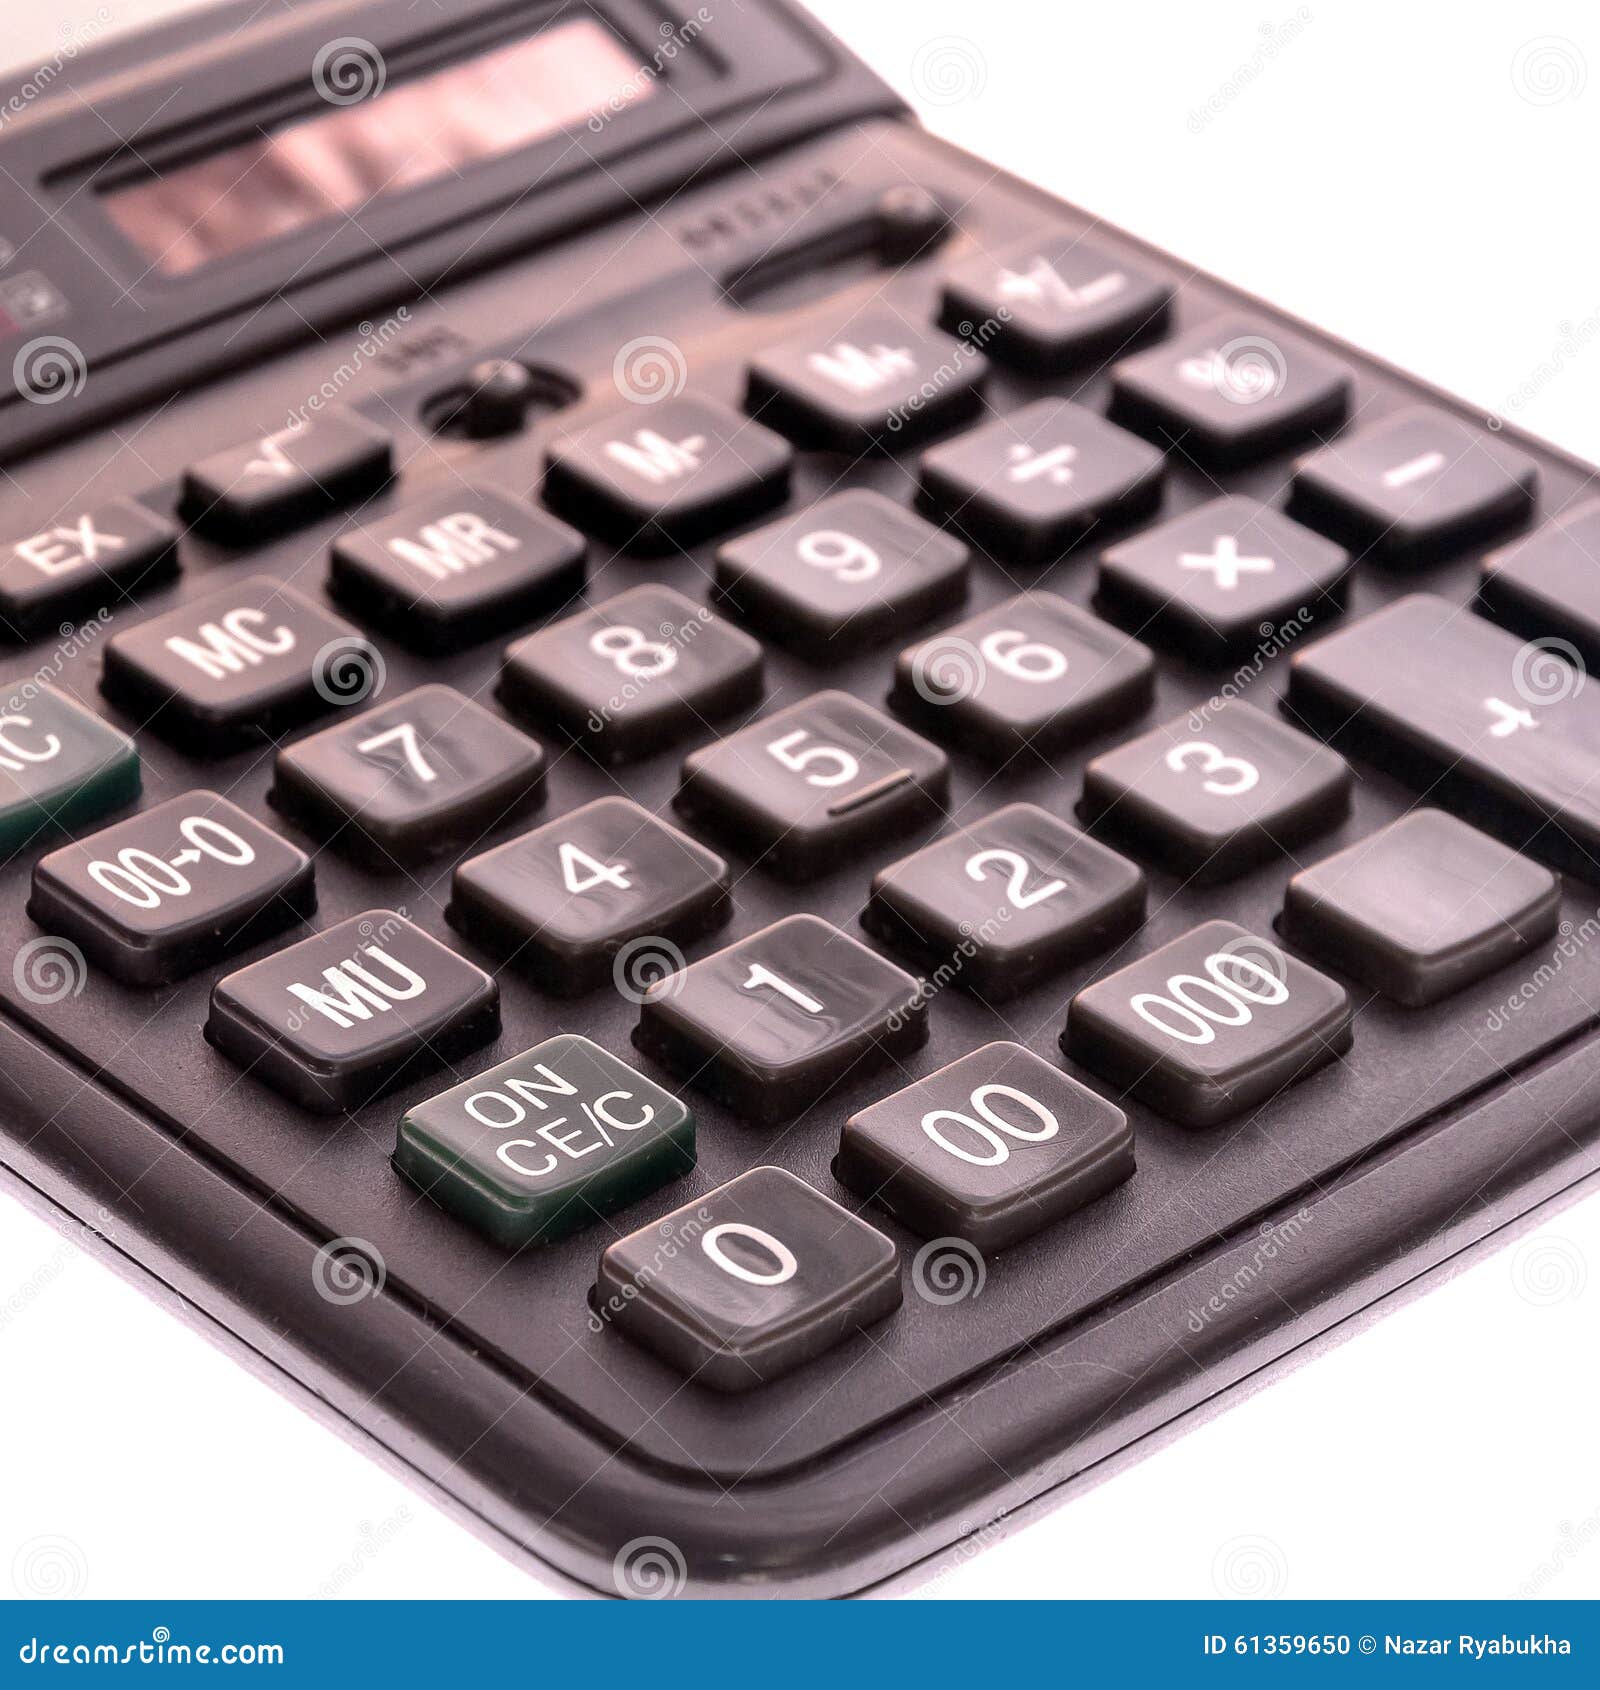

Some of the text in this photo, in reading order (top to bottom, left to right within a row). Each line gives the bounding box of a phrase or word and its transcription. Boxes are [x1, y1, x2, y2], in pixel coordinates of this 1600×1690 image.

[14, 515, 124, 576] EX
[389, 512, 519, 580] MR
[799, 531, 880, 582] 9
[166, 608, 295, 679] MC
[590, 626, 678, 678] 8
[980, 630, 1067, 682] 6
[0, 715, 61, 771] C
[358, 723, 436, 782] 7
[766, 729, 859, 787] 5
[1166, 741, 1259, 795] 3
[560, 842, 631, 894] 4
[965, 849, 1067, 910] 2
[286, 945, 427, 1028] MU
[743, 963, 824, 1013] 1
[1130, 952, 1289, 1044] 000
[464, 1063, 579, 1129] ON
[921, 1084, 1059, 1167] 00
[496, 1091, 655, 1176] CE/C
[702, 1223, 797, 1286] 0
